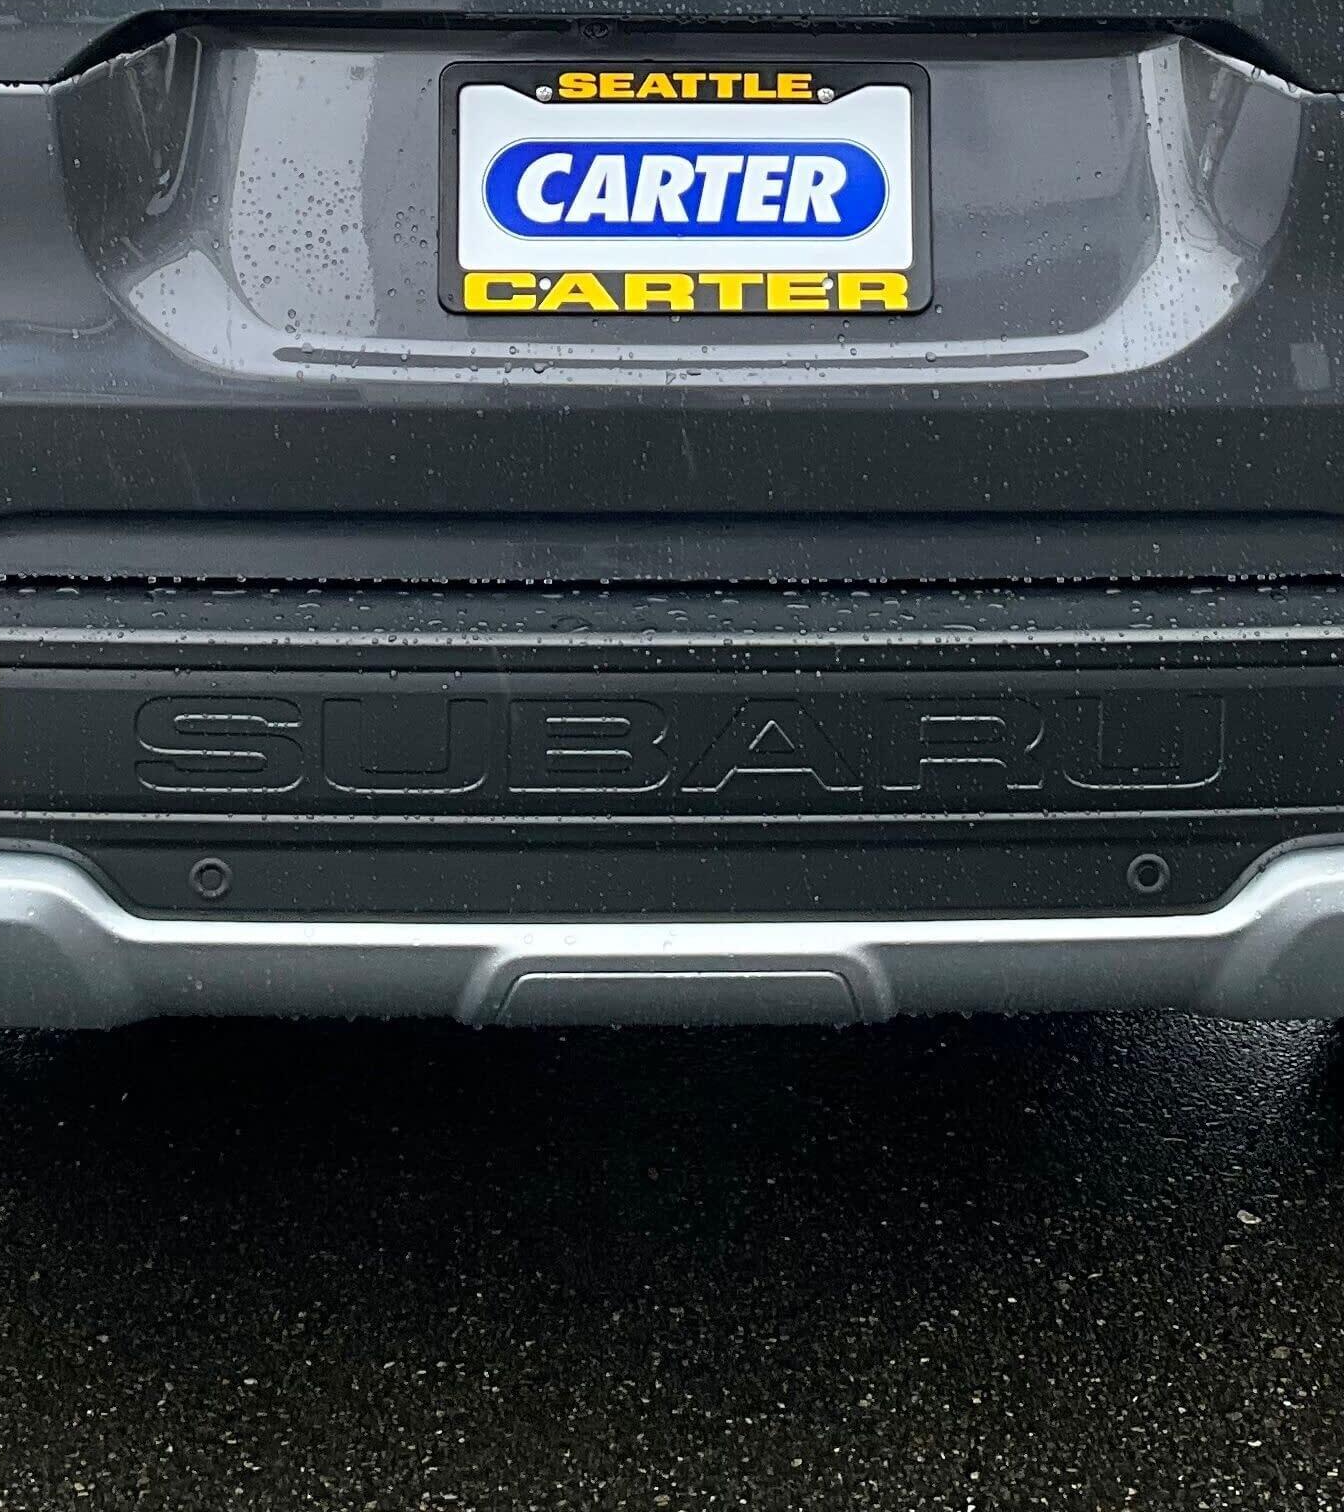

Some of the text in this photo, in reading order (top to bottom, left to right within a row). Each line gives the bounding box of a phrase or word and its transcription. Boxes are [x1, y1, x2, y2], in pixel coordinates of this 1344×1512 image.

[558, 72, 812, 99] SEATTLE
[517, 152, 847, 224] CARTER
[463, 272, 909, 311] CARTER
[134, 694, 1225, 794] SUBARU
